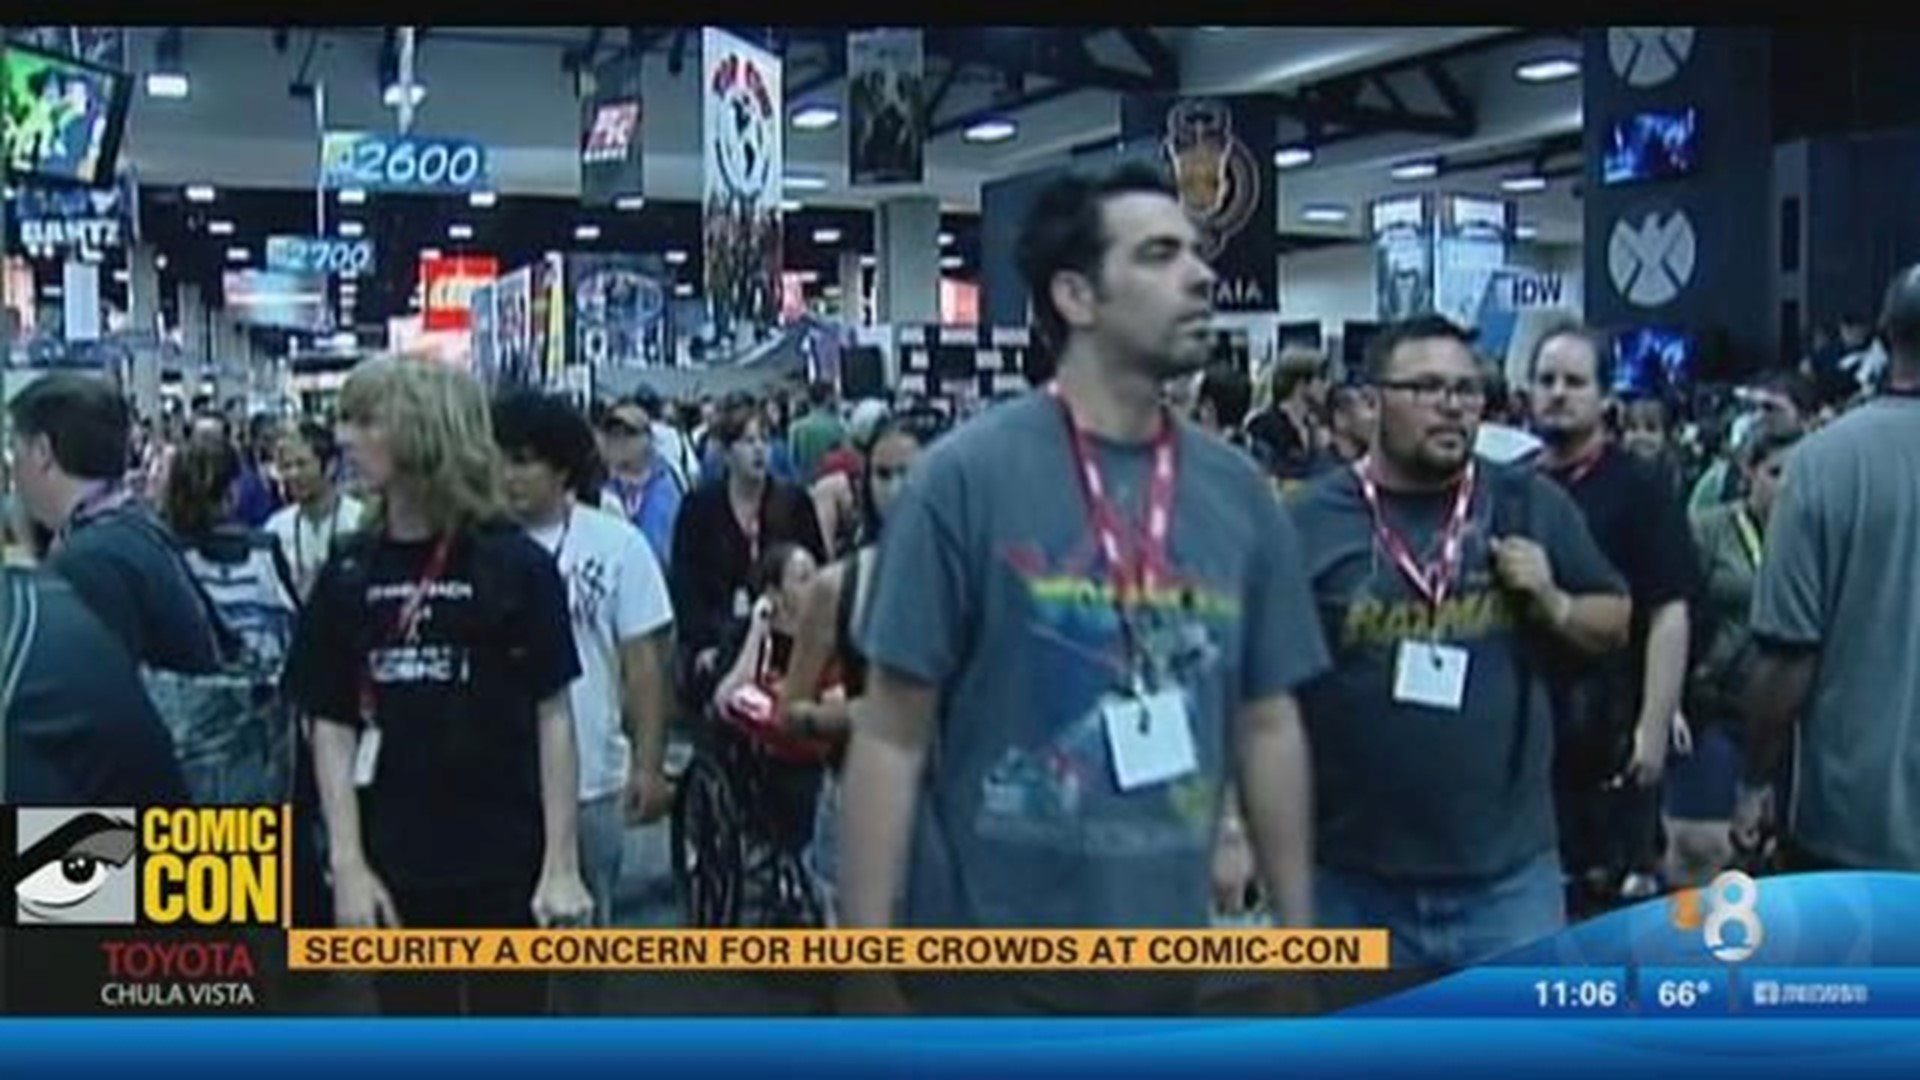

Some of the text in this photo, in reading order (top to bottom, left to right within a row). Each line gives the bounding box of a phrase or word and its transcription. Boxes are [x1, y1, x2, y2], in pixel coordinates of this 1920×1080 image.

[356, 142, 478, 184] 2600
[286, 240, 371, 271] 2700
[1512, 276, 1562, 305] IDW
